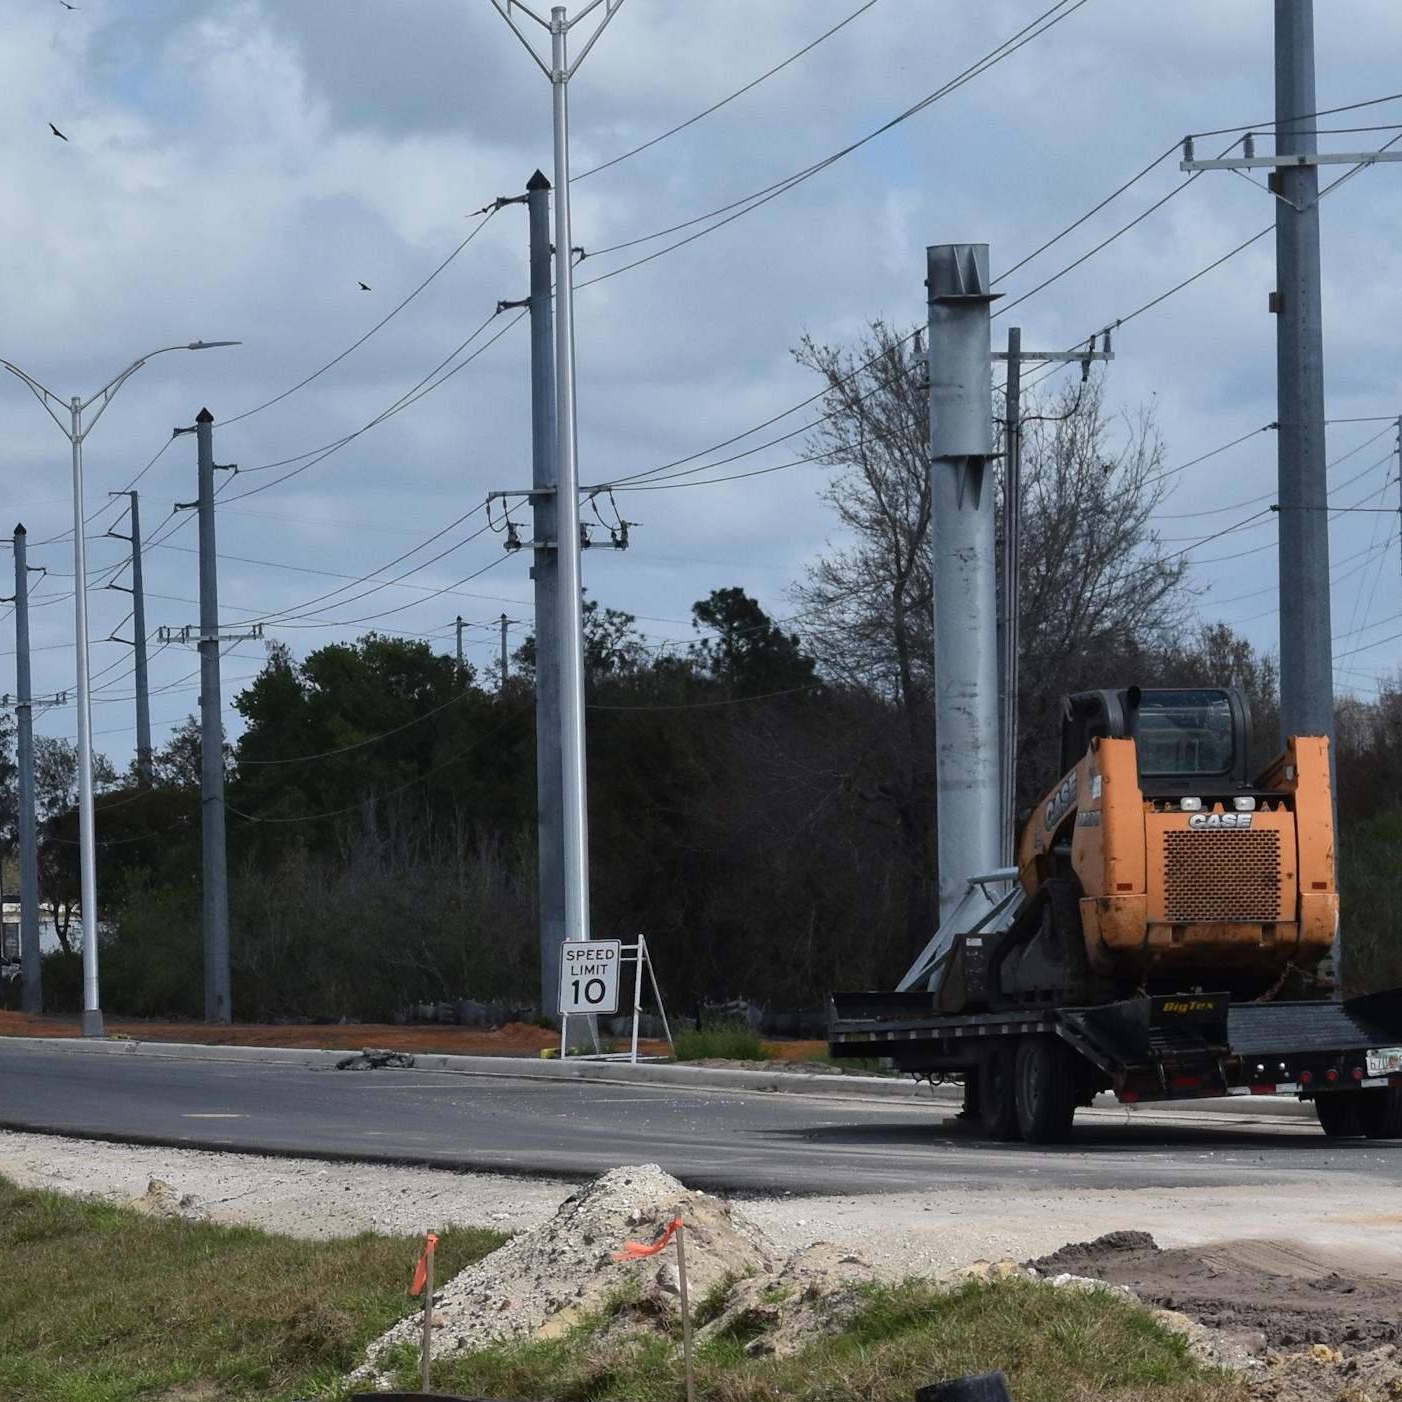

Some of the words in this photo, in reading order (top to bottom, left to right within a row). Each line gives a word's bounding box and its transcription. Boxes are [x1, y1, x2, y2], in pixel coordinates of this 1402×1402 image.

[1189, 813, 1253, 829] CASE
[566, 949, 615, 961] SPEED
[571, 964, 608, 976] LIMIT
[572, 978, 606, 1005] 10
